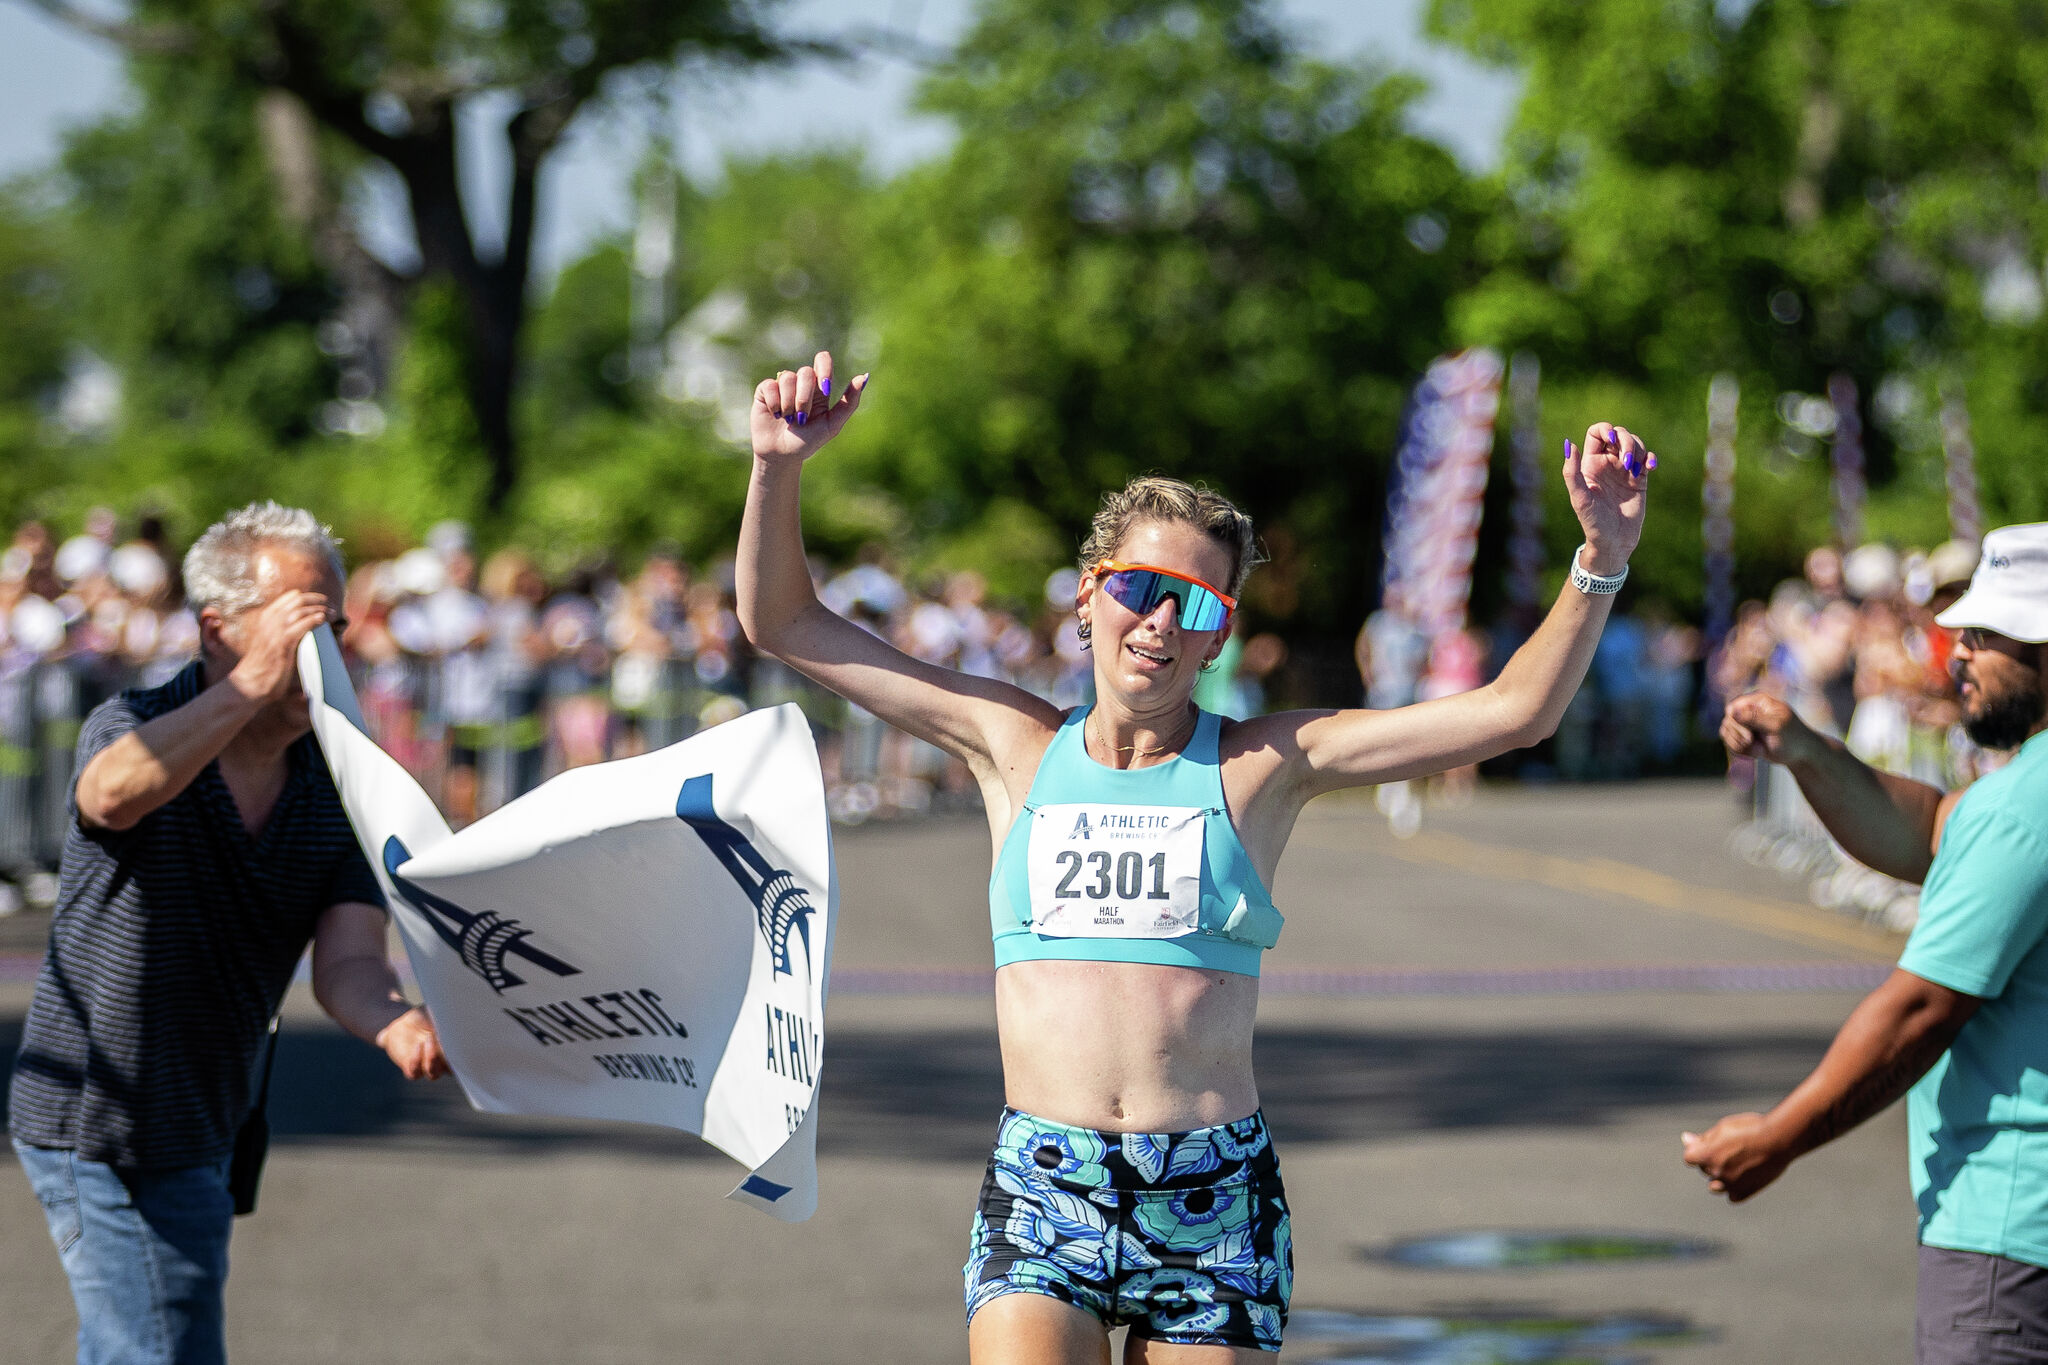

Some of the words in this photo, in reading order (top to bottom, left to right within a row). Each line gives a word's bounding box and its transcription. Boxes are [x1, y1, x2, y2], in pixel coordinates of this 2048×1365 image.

[1100, 814, 1170, 828] ATHLETIC
[1110, 832, 1145, 840] BREWING
[1054, 850, 1170, 900] 2301
[1099, 906, 1120, 917] HALF
[1093, 917, 1125, 925] MARATHON
[503, 987, 689, 1046] ATHLETIC
[593, 1053, 678, 1084] BREWING
